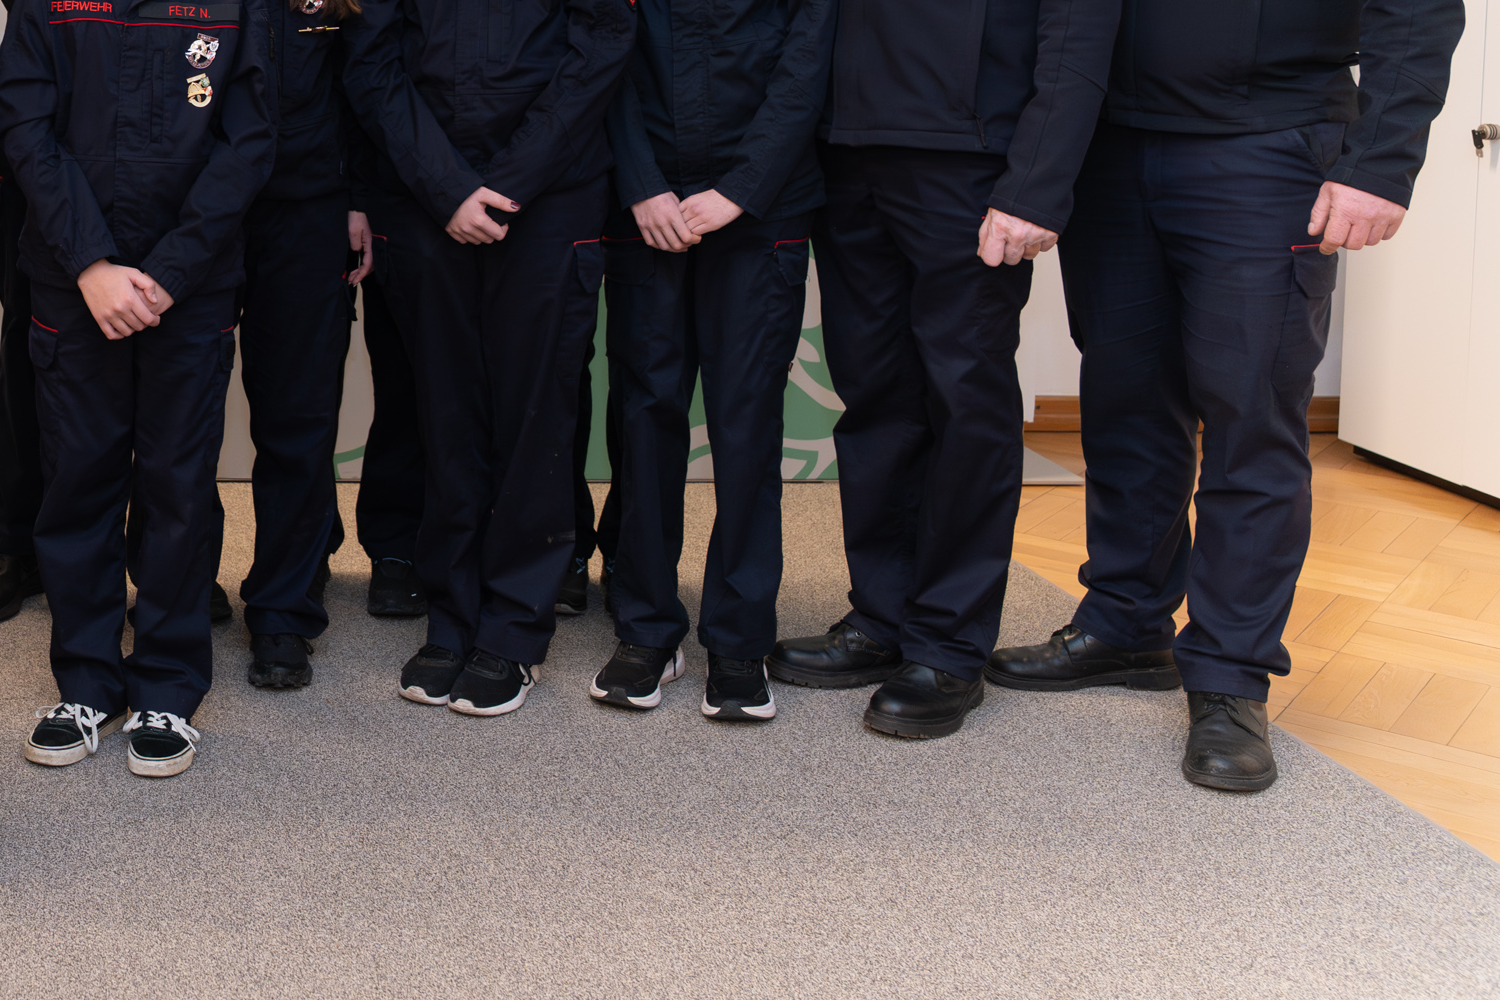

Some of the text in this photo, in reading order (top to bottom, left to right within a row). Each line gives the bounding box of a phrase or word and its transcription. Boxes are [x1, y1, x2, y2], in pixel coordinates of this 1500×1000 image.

[51, 0, 112, 12] FEERWEHR
[169, 6, 211, 18] FETZ N.
